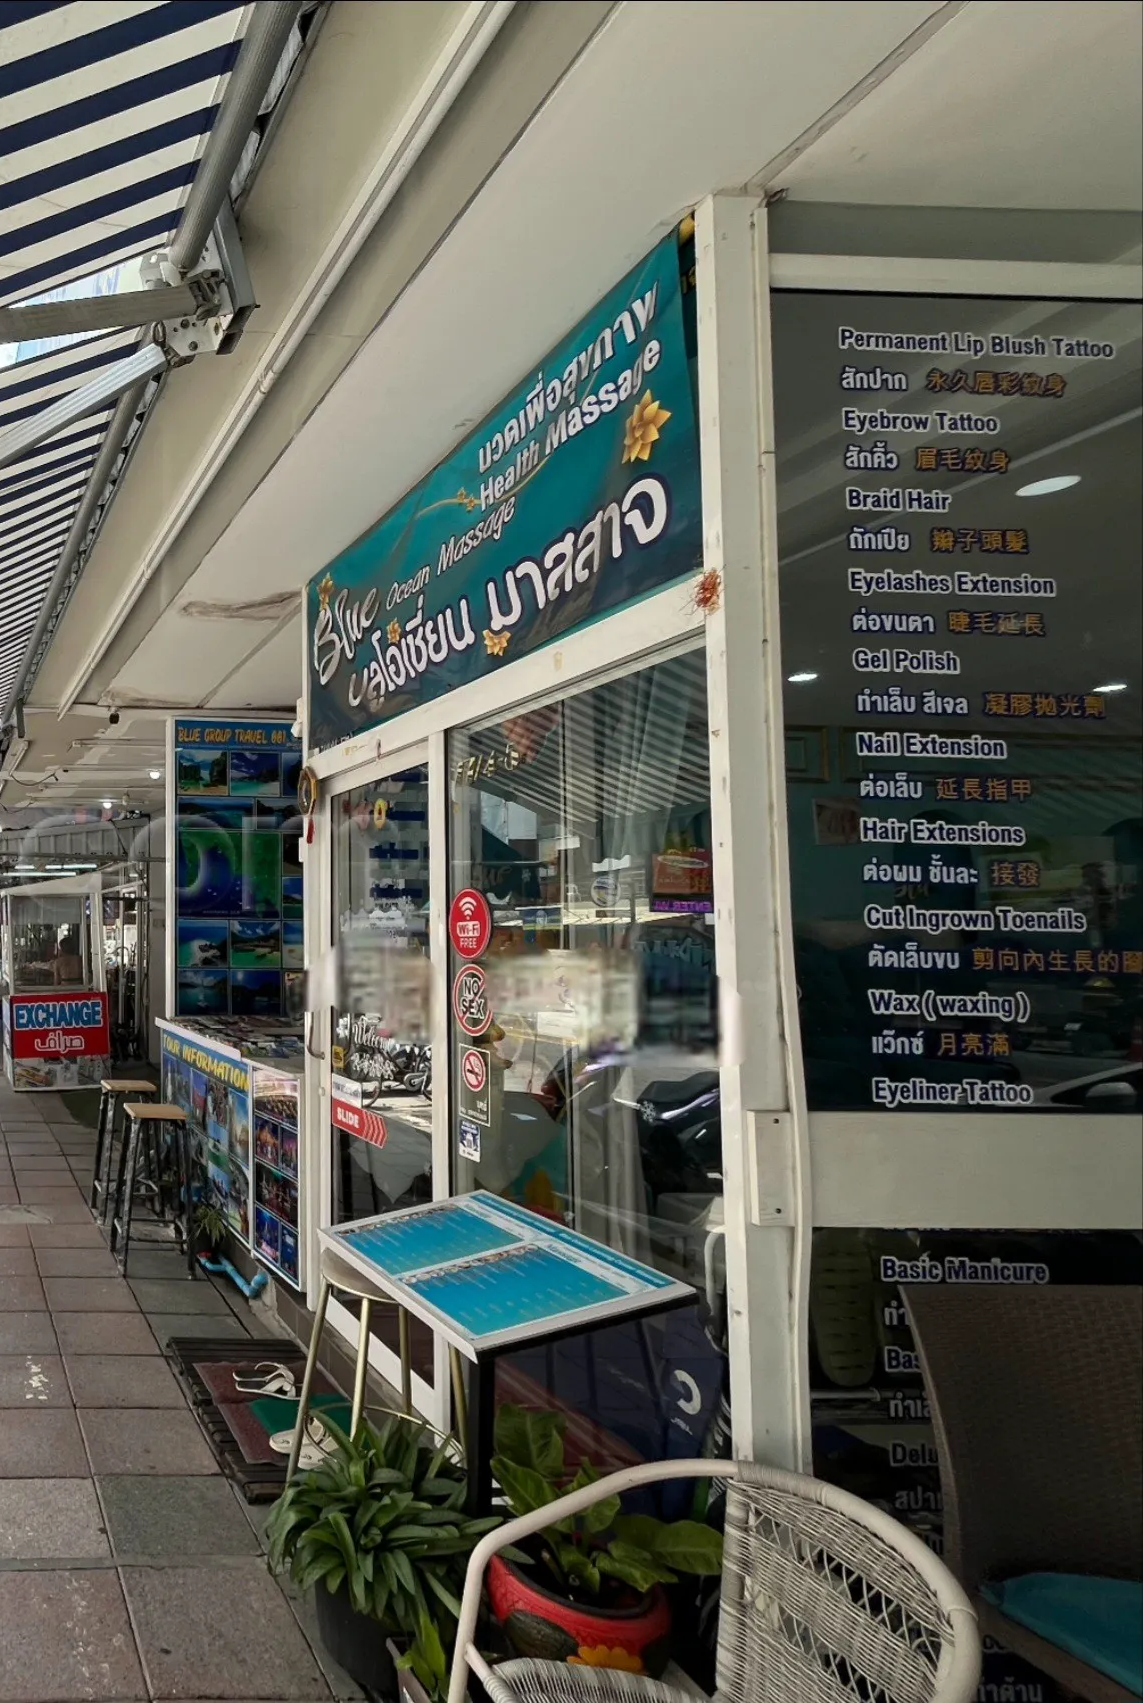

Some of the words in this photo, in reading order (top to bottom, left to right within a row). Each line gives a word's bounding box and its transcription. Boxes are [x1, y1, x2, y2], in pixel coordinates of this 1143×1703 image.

[839, 328, 948, 353] Permanent
[953, 334, 985, 359] Lip
[991, 337, 1046, 356] Blush
[1053, 338, 1115, 358] Tattoo
[477, 283, 658, 474] นวดเพื่อสุขภาพ
[841, 366, 908, 392] สักปาก
[480, 440, 540, 512] Health
[544, 338, 662, 459] Massage
[842, 410, 929, 433] Eyebrow
[935, 412, 999, 432] Tattoo
[845, 441, 899, 470] สักคิ้ว
[914, 447, 1011, 473] 眉毛紋身
[846, 489, 901, 510] Braid
[907, 490, 951, 512] Hair
[848, 526, 909, 552] ถักเปีย
[487, 477, 669, 633] มาสสาจ
[313, 586, 379, 685] Blue
[386, 566, 430, 611] Ocean
[437, 495, 515, 573] Massage
[849, 570, 950, 594] Eyelashes
[956, 574, 1056, 596] Extension
[852, 607, 935, 634] ต่อขนตา
[947, 610, 1046, 637] 睫毛延長
[853, 649, 889, 671] Gel
[894, 650, 960, 674] Polish
[857, 686, 918, 714] ทำเล็บ
[922, 689, 968, 714] สีเจล
[178, 727, 201, 743] BLUE
[204, 728, 232, 743] GROUP
[235, 729, 267, 744] TRAVEL
[856, 732, 900, 756] Nail
[904, 734, 1006, 759] Extension
[860, 772, 922, 799] ต่อเล็บ
[936, 777, 1032, 803] 延長指甲
[861, 818, 909, 843] Hair
[910, 820, 1025, 845] Extensions
[863, 859, 922, 884] ต่อผม
[929, 854, 979, 884] ชั้นละ
[458, 922, 479, 936] Wi-Fi
[864, 904, 907, 930] Cut
[907, 907, 994, 935] Ingrown
[998, 908, 1087, 932] Toenails
[459, 938, 478, 949] FREE
[868, 942, 959, 969] ตัดเล็บขบ
[463, 977, 481, 996] NO
[461, 998, 485, 1019] SEX
[869, 989, 921, 1014] Wax
[13, 1000, 104, 1031] EXCHANGE
[35, 1030, 85, 1053] صراف
[163, 1035, 180, 1056] TOUR
[182, 1044, 250, 1091] INFORMATION
[872, 1078, 960, 1107] Eyeliner
[965, 1080, 1033, 1104] Tattoo
[337, 1107, 360, 1128] SLIDE
[881, 1257, 942, 1283] Basic
[945, 1257, 1049, 1284] Manicure
